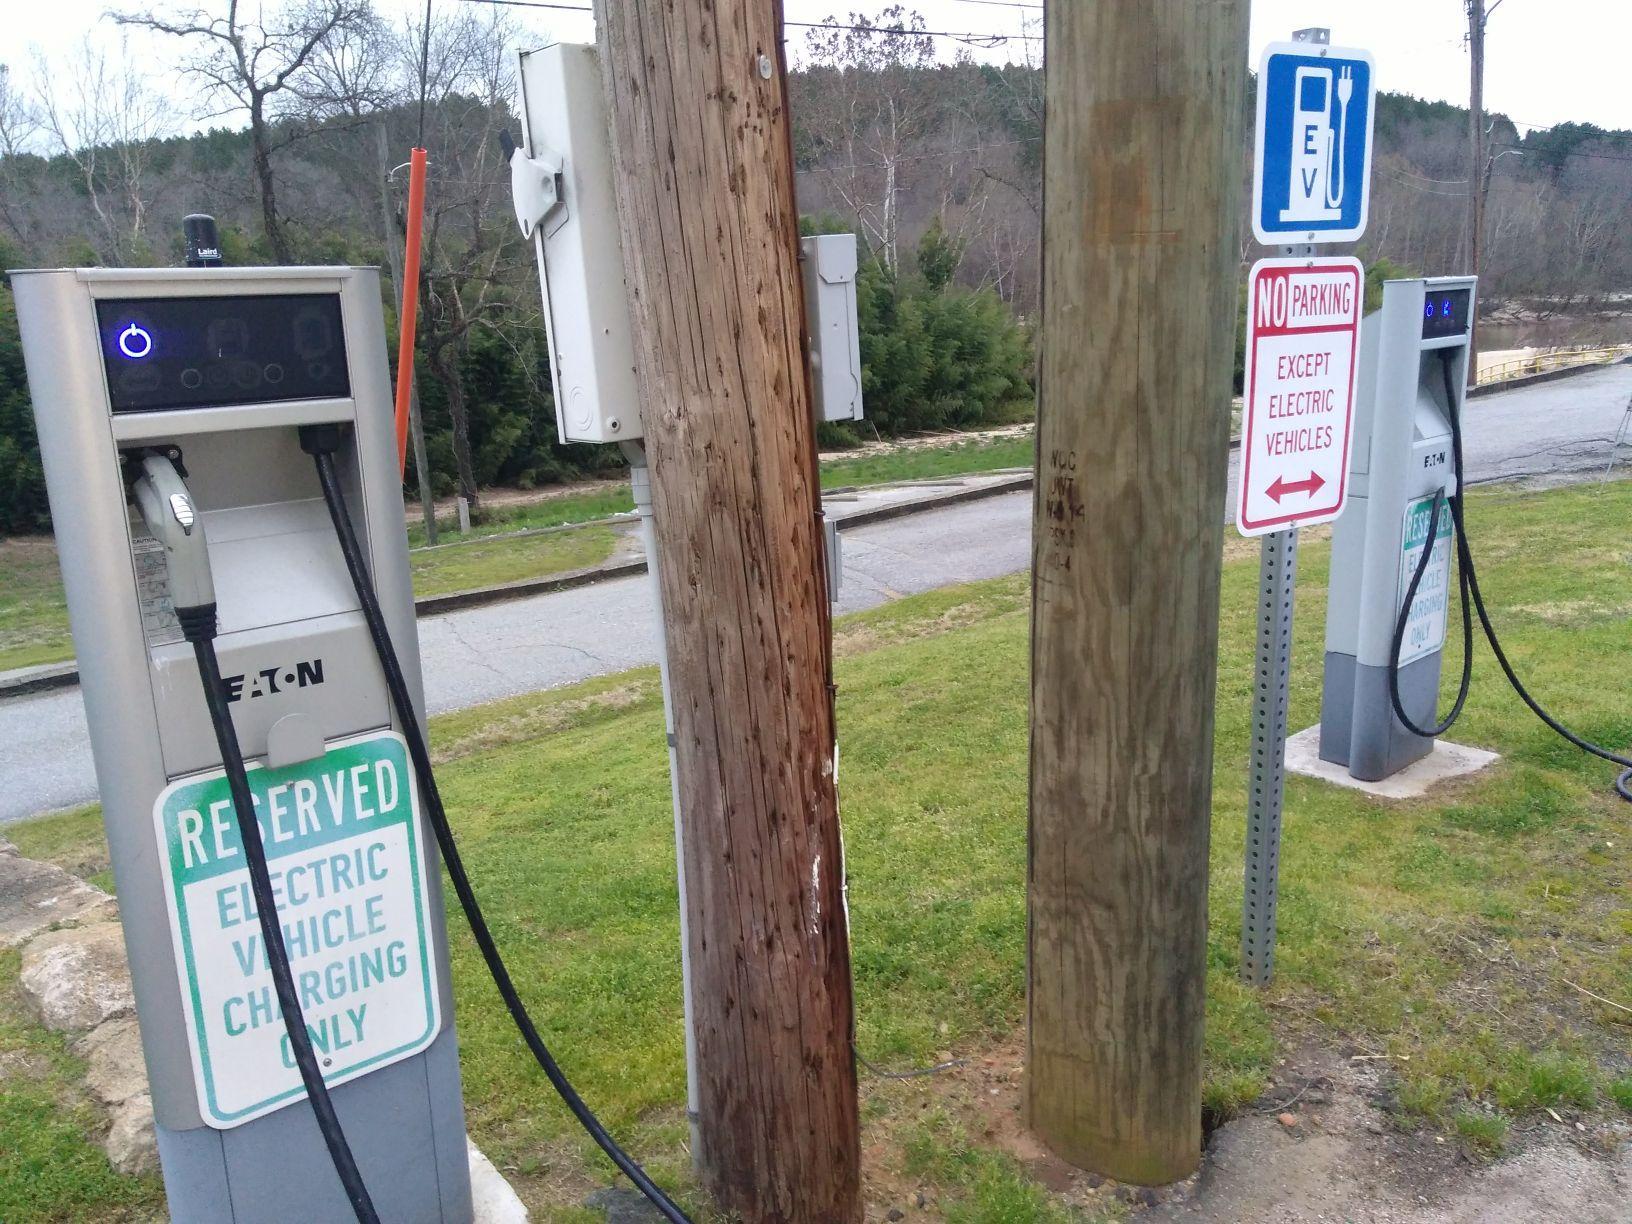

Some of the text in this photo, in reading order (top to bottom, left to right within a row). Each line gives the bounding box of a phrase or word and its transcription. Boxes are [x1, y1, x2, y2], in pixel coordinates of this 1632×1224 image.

[1257, 275, 1351, 328] NO PARKING
[1277, 352, 1331, 380] EXCEPT
[1269, 389, 1334, 419] ELECTRIC
[1266, 425, 1332, 456] VEHICLES
[1406, 504, 1452, 543] RESEED
[1409, 544, 1444, 574] ELRIC
[1411, 568, 1442, 595] HICLE
[1407, 592, 1443, 623] HARGING
[219, 659, 324, 703] EATON
[223, 940, 407, 1036] CHRGING
